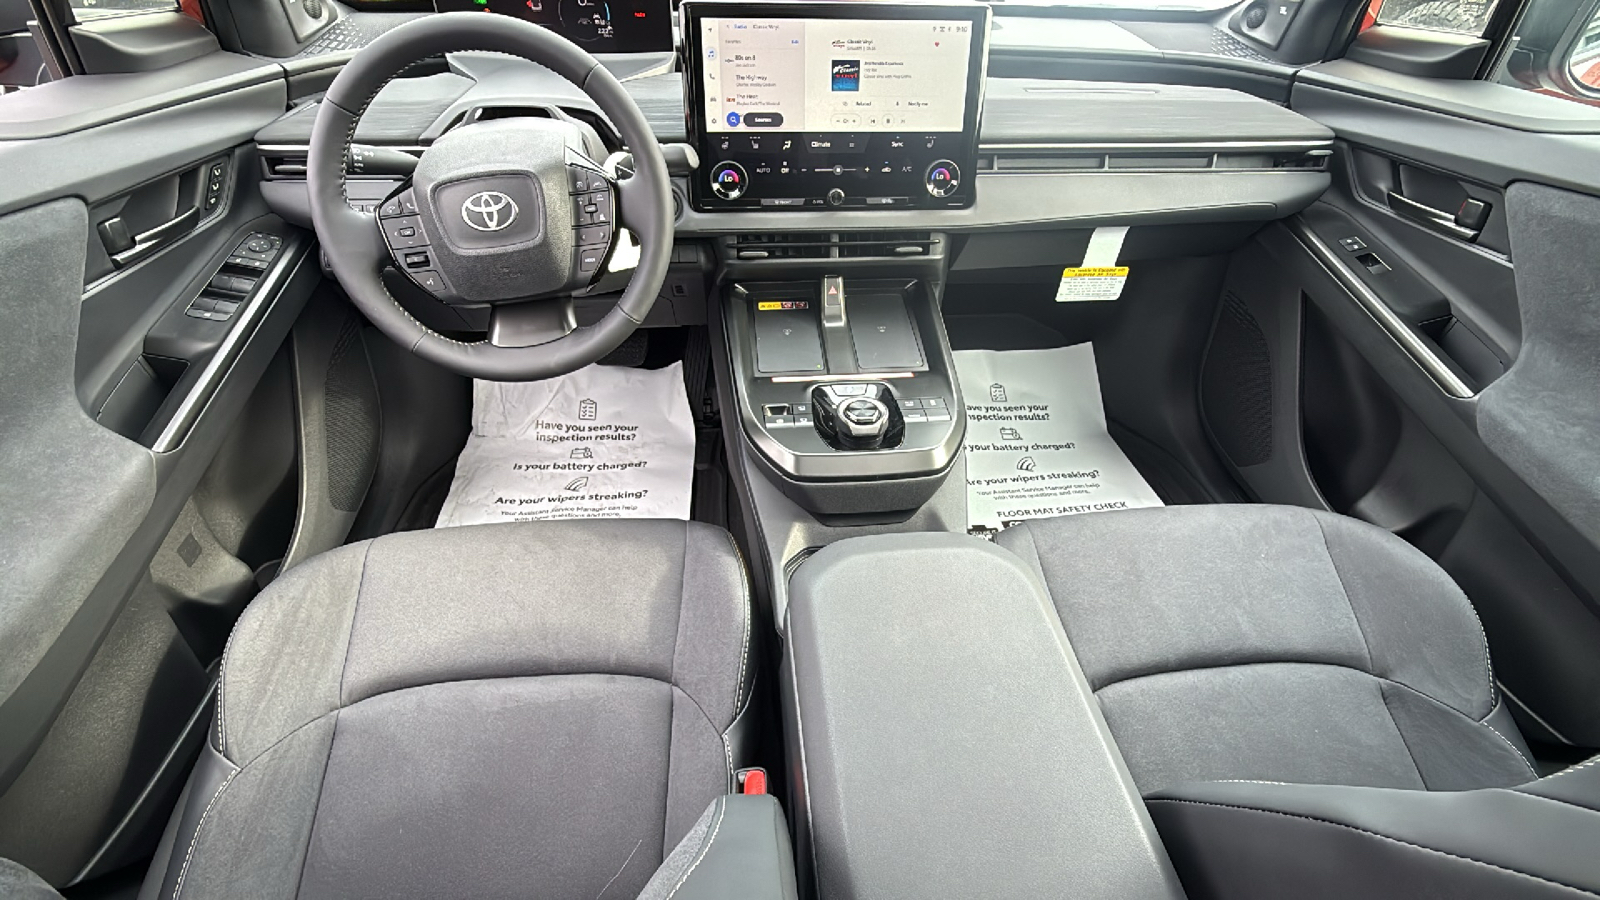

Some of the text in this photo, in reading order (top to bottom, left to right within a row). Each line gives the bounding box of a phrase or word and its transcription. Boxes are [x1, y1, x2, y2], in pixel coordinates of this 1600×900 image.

[1014, 413, 1050, 421] results?
[535, 420, 639, 433] Have you seen your
[536, 432, 636, 444] inspection results?
[968, 444, 990, 452] your
[992, 443, 1029, 452] battery
[1031, 442, 1076, 451] charged?
[524, 464, 551, 472] your
[552, 462, 595, 472] battery
[597, 461, 647, 471] charged?
[984, 478, 1008, 486] your
[1010, 475, 1045, 483] wipers
[1047, 470, 1100, 479] streaking?
[495, 490, 648, 506] Are your wipers streaking?
[997, 501, 1128, 518] FLOOR MAT SAFETY CHECK
